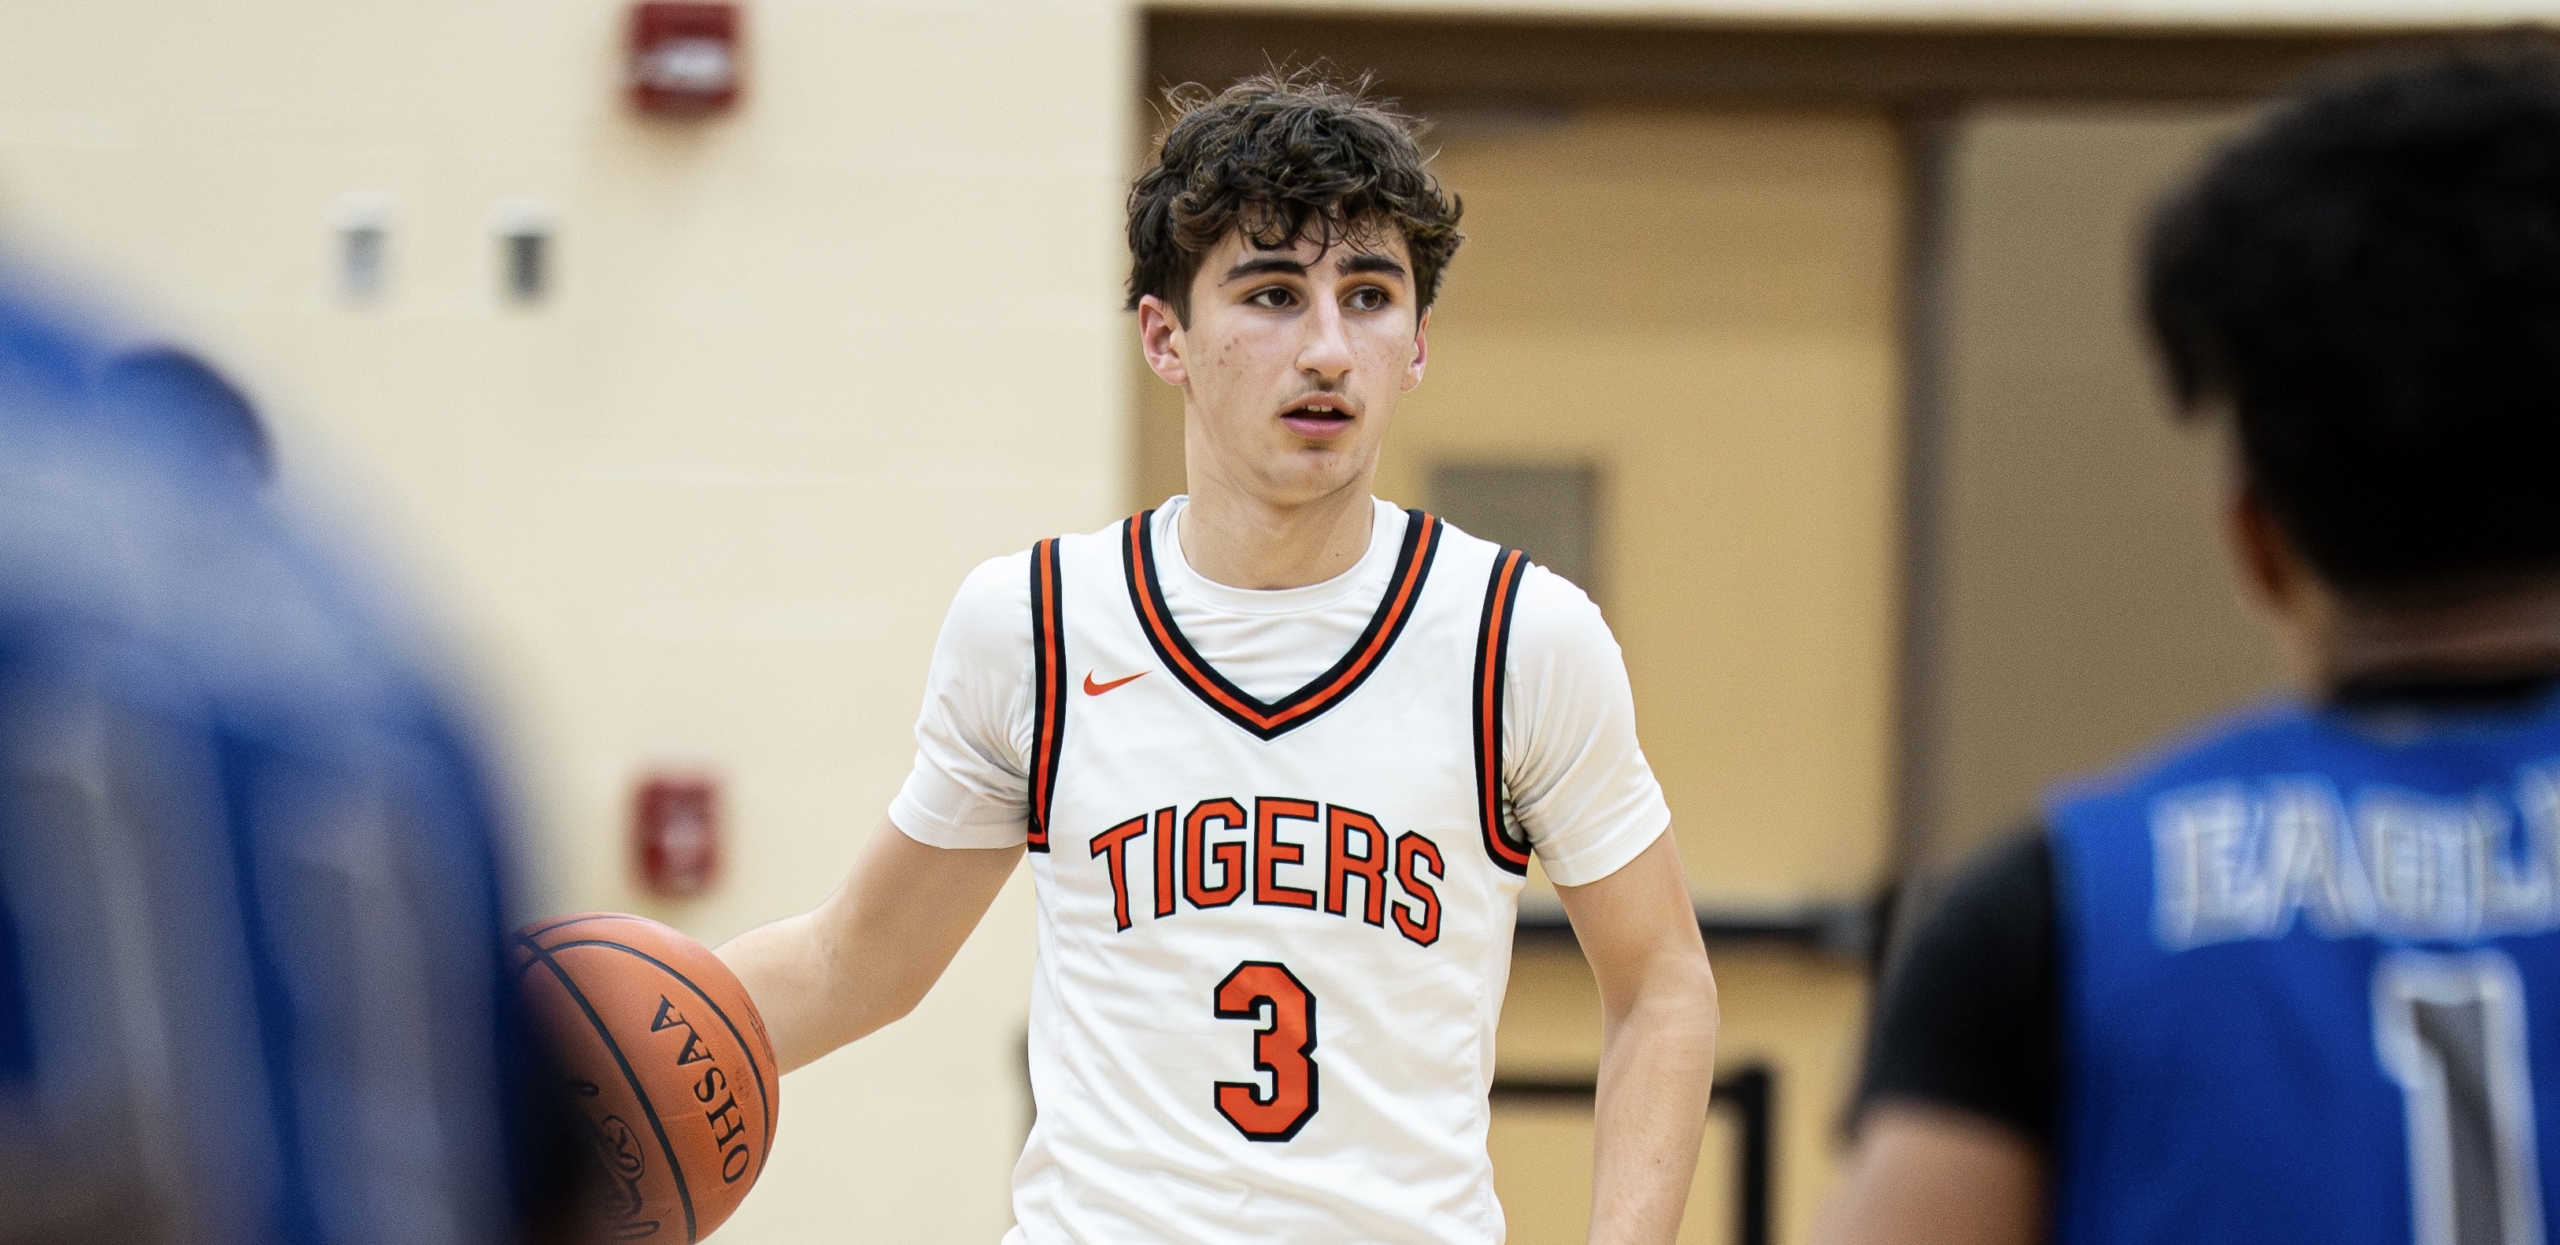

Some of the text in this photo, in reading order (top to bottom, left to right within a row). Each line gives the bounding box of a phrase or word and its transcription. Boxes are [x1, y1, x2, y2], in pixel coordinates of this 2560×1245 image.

[1089, 795, 1446, 949] TIGERS
[650, 994, 750, 1185] OHSAA
[1213, 960, 1320, 1143] 3
[2371, 950, 2548, 1245] 1
